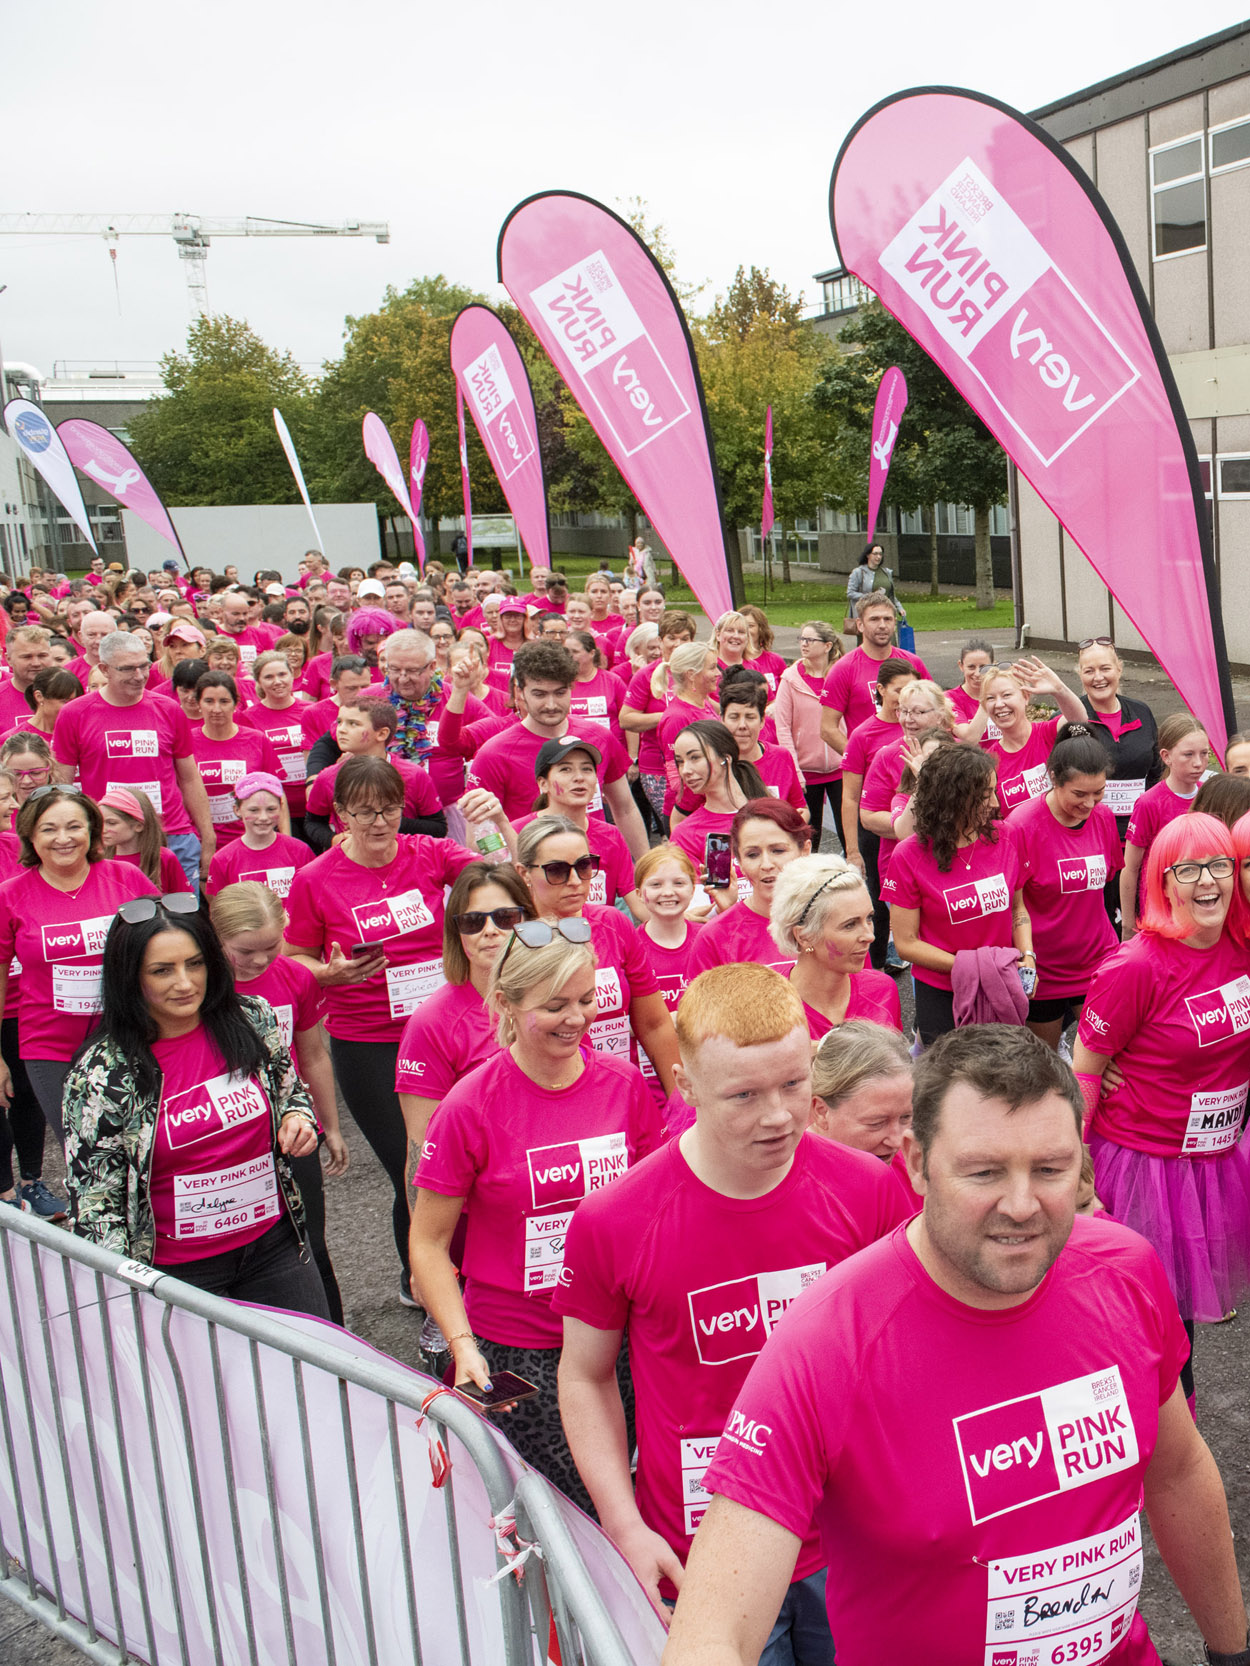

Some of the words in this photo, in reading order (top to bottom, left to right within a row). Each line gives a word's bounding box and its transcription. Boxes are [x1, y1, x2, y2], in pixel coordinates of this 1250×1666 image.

[109, 739, 131, 748] very
[269, 734, 288, 742] very
[200, 769, 221, 778] very
[1005, 782, 1026, 796] very
[1028, 775, 1048, 788] PINK
[1031, 782, 1049, 795] RUN
[1063, 869, 1086, 880] very
[1090, 867, 1106, 877] PINK
[1090, 876, 1106, 886] RUN
[982, 887, 1008, 902] PINK
[950, 895, 978, 911] very
[984, 899, 1007, 911] RUN
[395, 902, 424, 920] PINK
[360, 912, 391, 930] very
[400, 912, 428, 930] RUN
[47, 933, 81, 947] very
[87, 930, 108, 941] PIN
[89, 940, 106, 951] RU
[58, 969, 80, 977] VERY
[392, 968, 416, 978] VERY
[418, 963, 437, 974] PINK
[596, 982, 618, 997] INK
[661, 989, 679, 1001] ery
[597, 995, 617, 1009] UN
[1086, 1006, 1111, 1032] UPMC
[1196, 1006, 1227, 1026] very
[605, 1021, 625, 1031] RUN
[218, 1085, 257, 1106] PINK
[1198, 1097, 1222, 1106] VERY
[1223, 1094, 1238, 1103] PINK
[170, 1101, 213, 1127] very
[227, 1099, 260, 1122] RUN
[1212, 1133, 1231, 1147] 1445
[589, 1154, 625, 1175] PINK
[183, 1177, 218, 1189] VERY
[220, 1168, 247, 1184] PINK
[249, 1160, 269, 1174] RUN
[535, 1162, 580, 1184] very
[214, 1212, 248, 1229] 6460
[536, 1218, 568, 1232] VERY
[699, 1304, 759, 1335] very
[1093, 1382, 1118, 1397] CANCER
[1094, 1389, 1119, 1402] IRELAND
[728, 1409, 772, 1447] PMC
[1057, 1404, 1127, 1450] PINK
[693, 1446, 716, 1459] VE
[969, 1431, 1043, 1478] very
[1063, 1435, 1125, 1478] RUN
[1003, 1558, 1058, 1584] VERY
[1062, 1543, 1105, 1572] PINK
[1109, 1526, 1135, 1556] RUN
[1051, 1631, 1103, 1665] 6395
[1019, 1655, 1040, 1663] PINK
